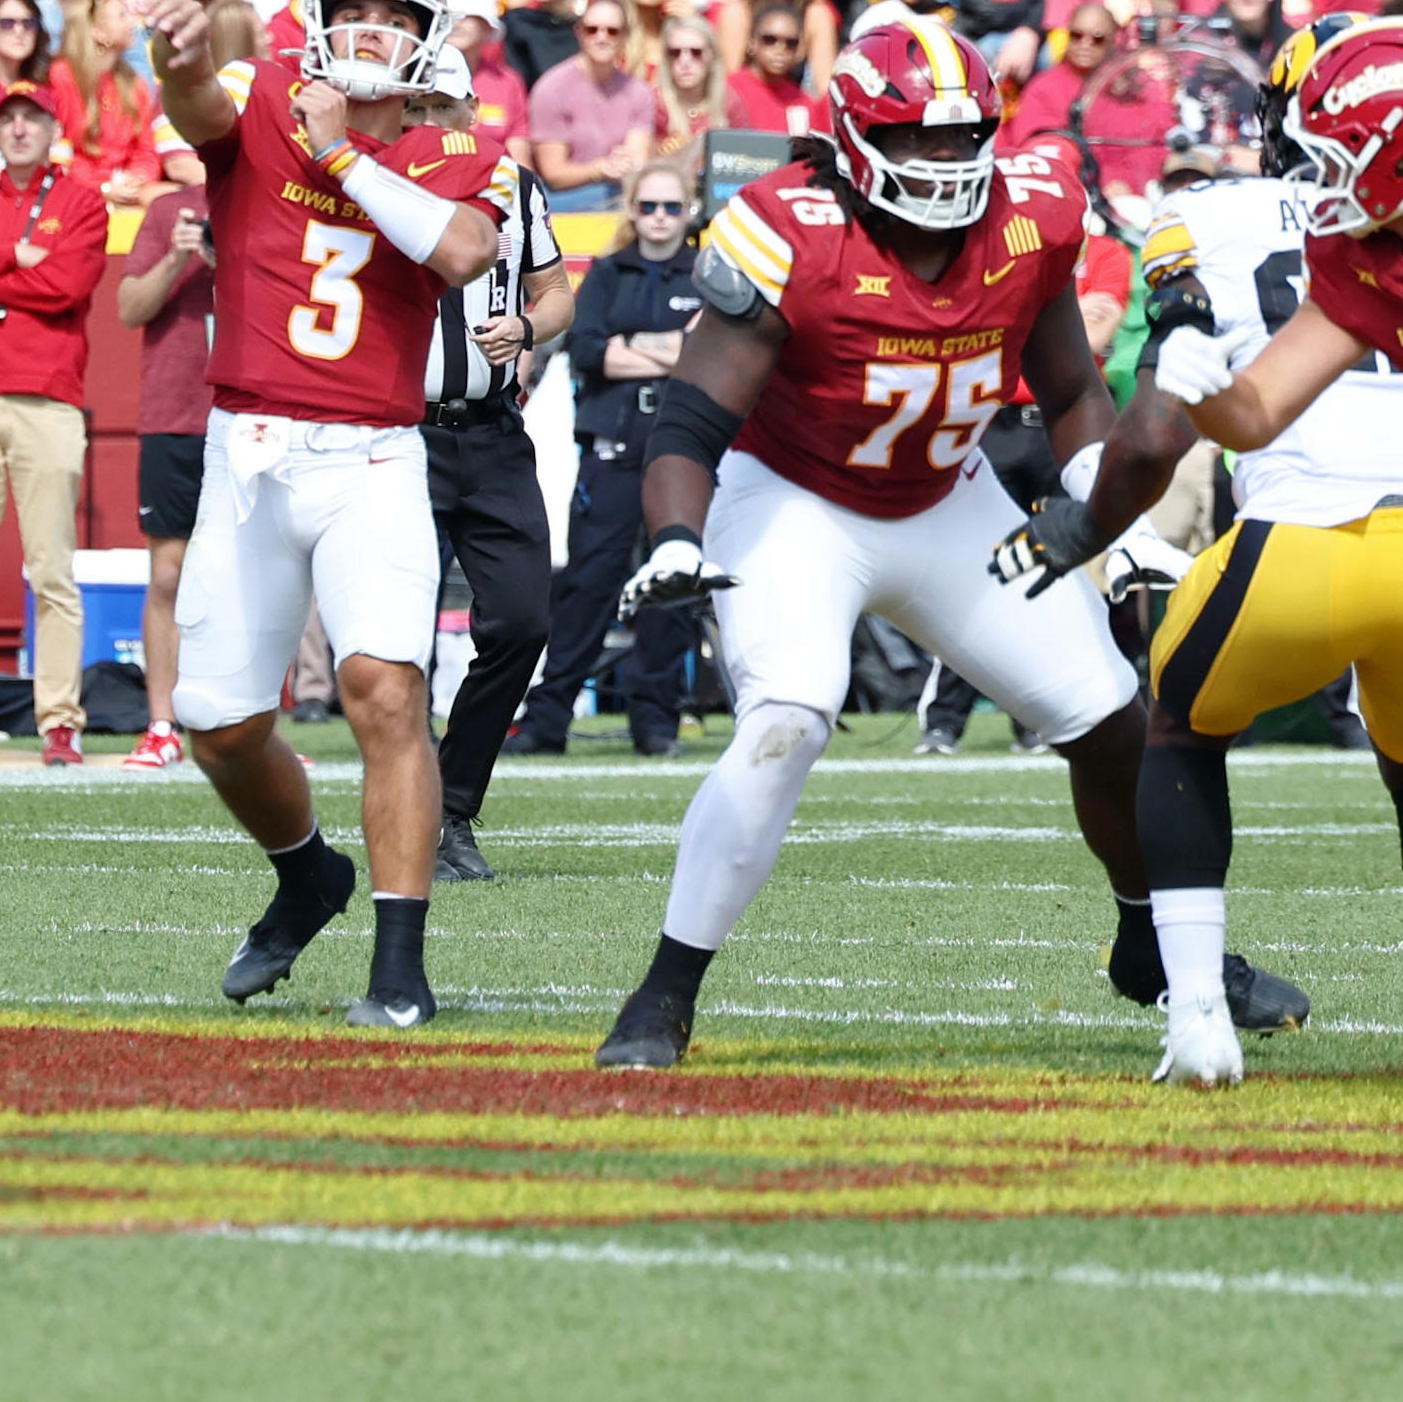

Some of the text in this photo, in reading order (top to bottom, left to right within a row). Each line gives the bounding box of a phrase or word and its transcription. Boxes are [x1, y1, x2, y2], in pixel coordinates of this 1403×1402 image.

[280, 180, 336, 216] IOWA
[994, 152, 1064, 205] 75
[286, 218, 377, 361] 3
[490, 286, 506, 312] R
[876, 327, 1005, 358] IOWA STATE
[846, 346, 1004, 471] 75
